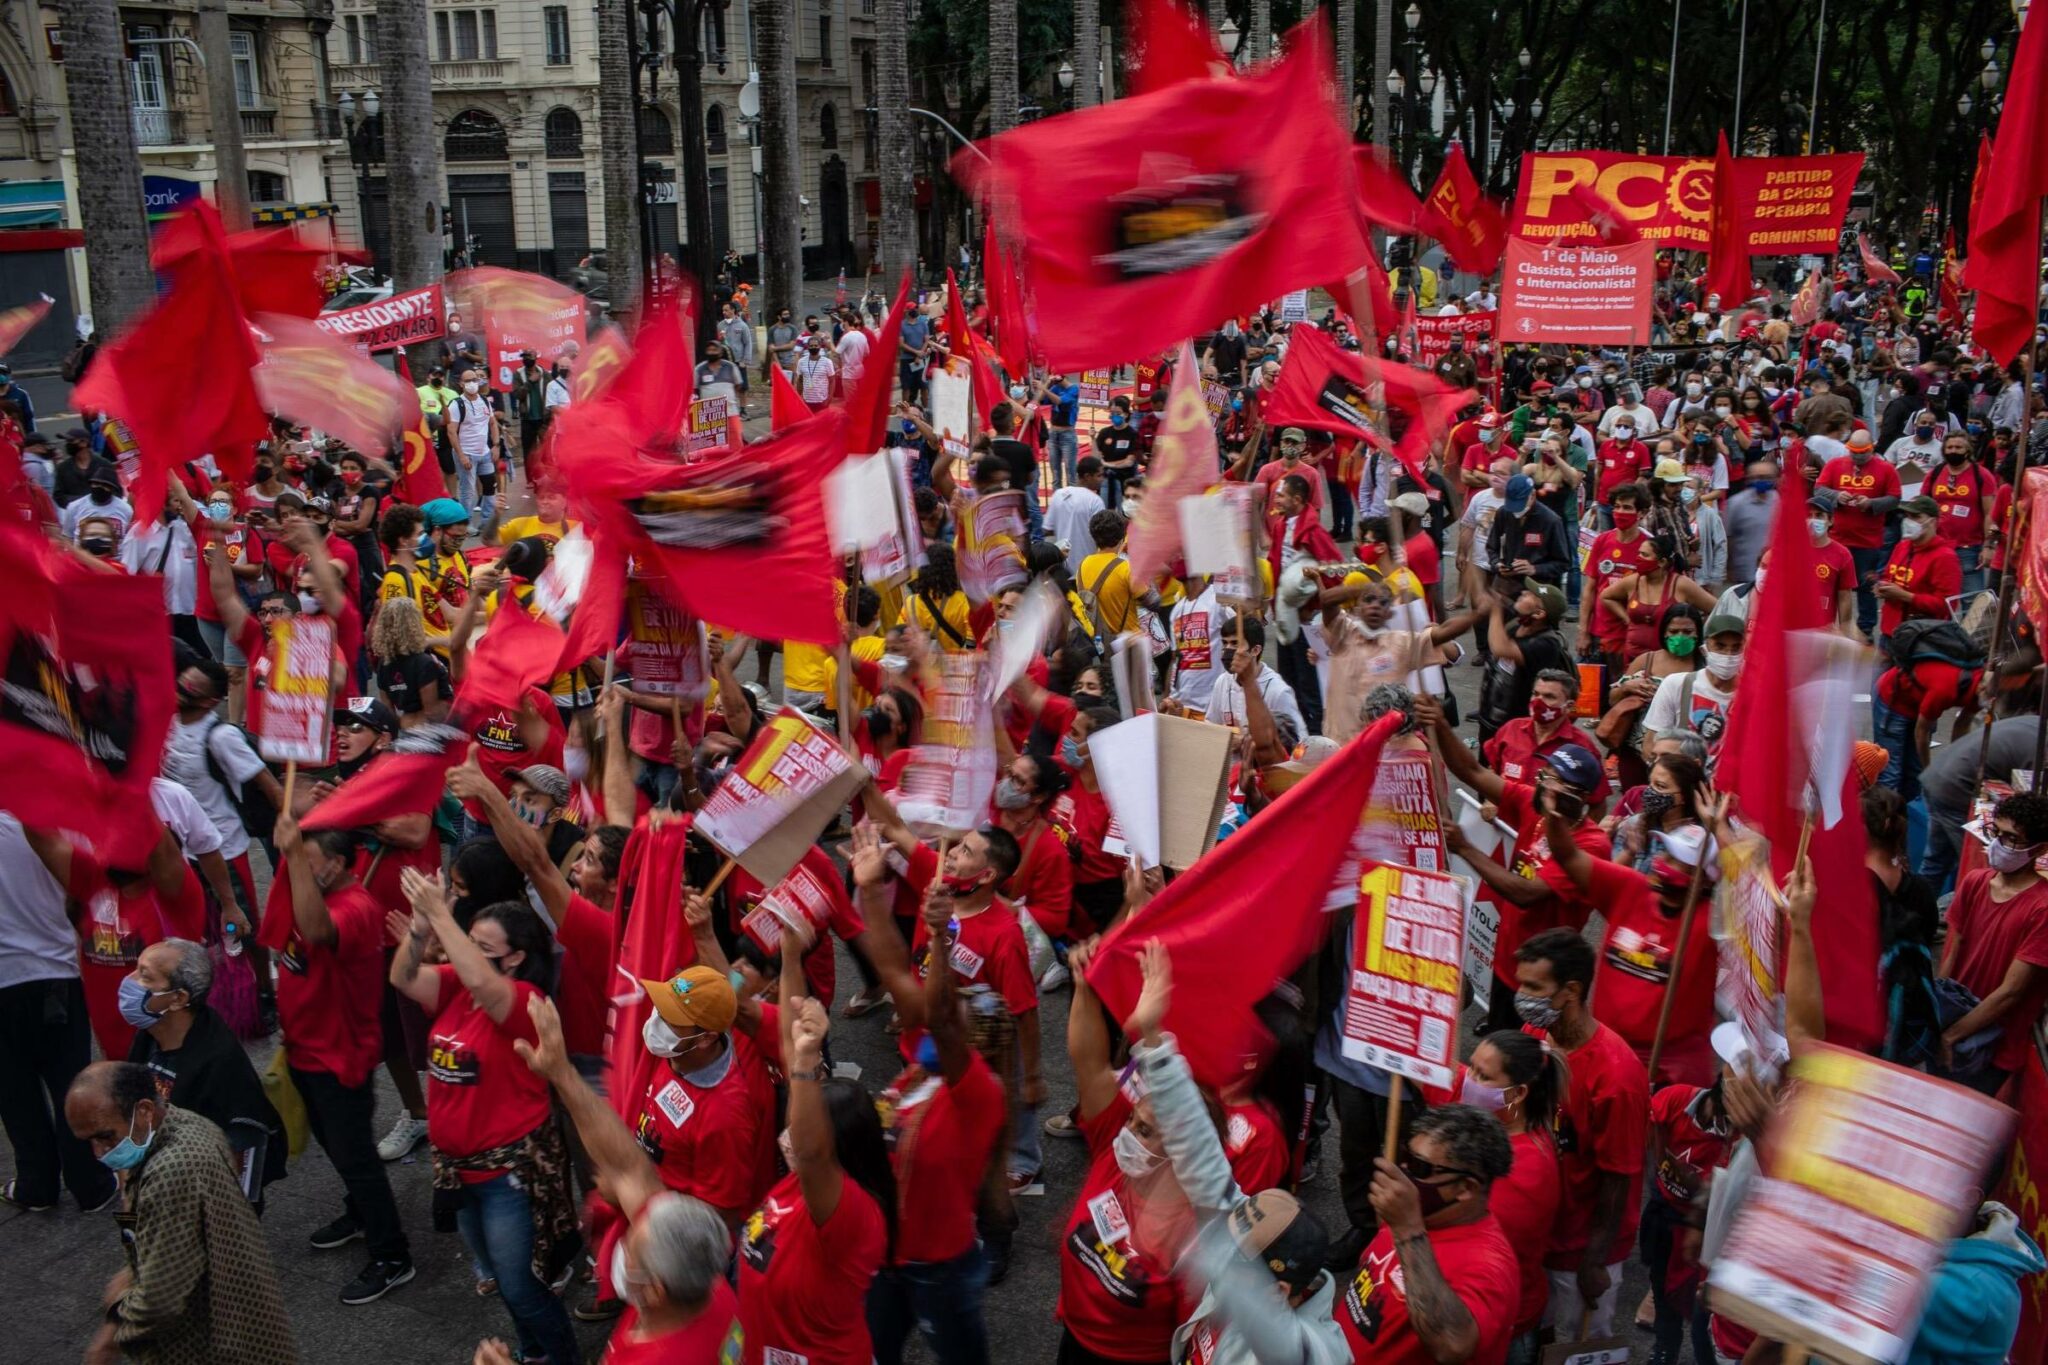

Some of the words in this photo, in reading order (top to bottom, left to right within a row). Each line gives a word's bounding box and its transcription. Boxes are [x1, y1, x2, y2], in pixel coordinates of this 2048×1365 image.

[1766, 170, 1832, 184] PARTIDO
[1758, 187, 1779, 201] DA
[1783, 184, 1833, 200] CAUSA
[1749, 228, 1837, 245] COMUNISMO
[1558, 250, 1577, 263] de
[1581, 250, 1618, 263] Maio
[1518, 262, 1576, 278] Classista,
[1579, 265, 1637, 277] Socialista
[1516, 278, 1524, 287] e
[1527, 276, 1636, 290] Internacionalista!
[315, 291, 434, 334] PRESIDENTE
[1438, 315, 1493, 334] defesa
[487, 726, 513, 742] FNL
[1392, 763, 1427, 780] MAIO
[1392, 794, 1434, 814] LUTA
[1400, 814, 1439, 831] RUAS
[1419, 831, 1440, 846] 14H
[1384, 916, 1412, 954] DE
[1411, 922, 1461, 969] LUTA
[953, 946, 979, 969] FORA
[1415, 956, 1458, 997] RUAS
[668, 1083, 692, 1116] FORA
